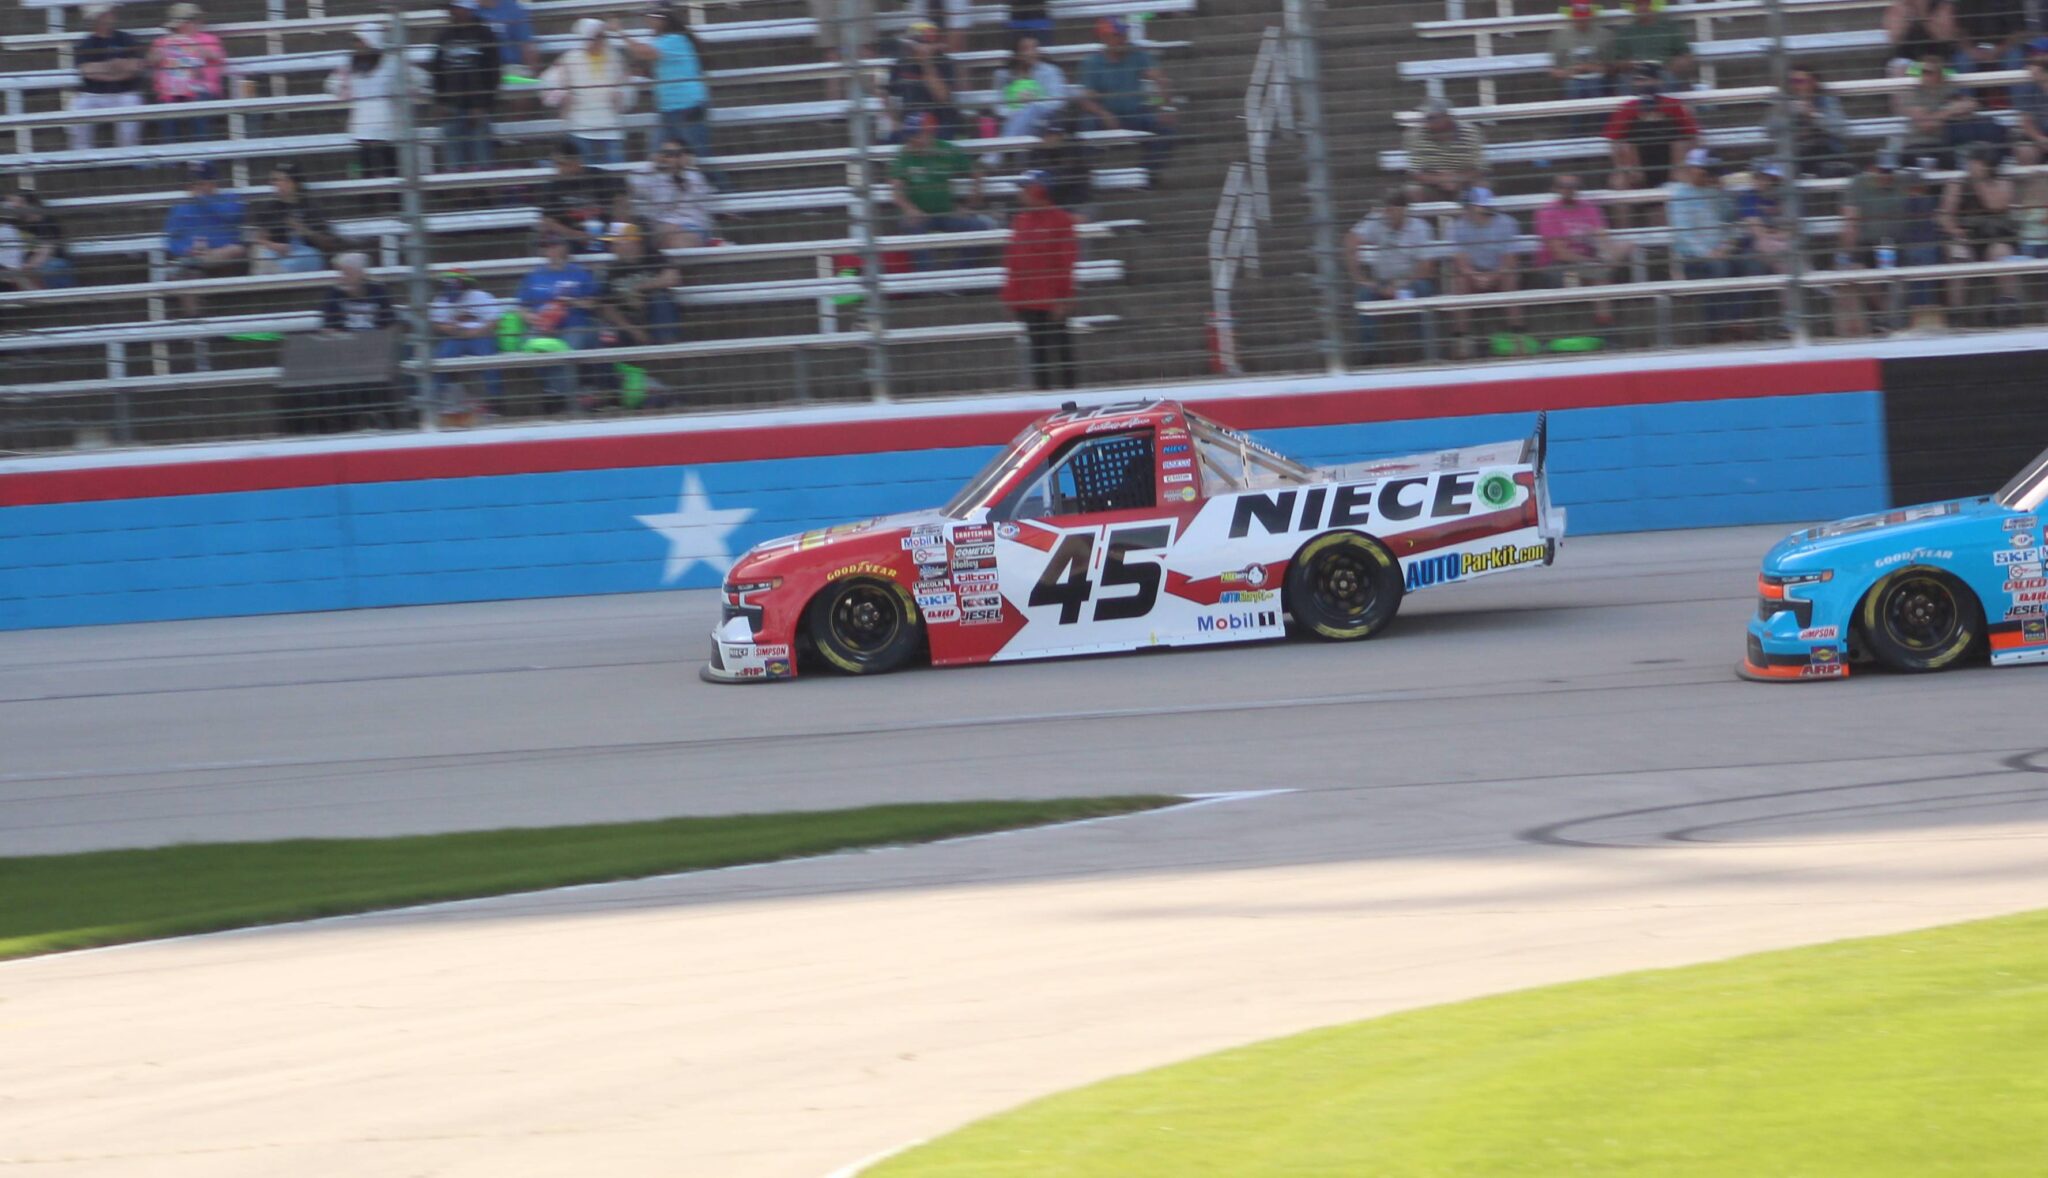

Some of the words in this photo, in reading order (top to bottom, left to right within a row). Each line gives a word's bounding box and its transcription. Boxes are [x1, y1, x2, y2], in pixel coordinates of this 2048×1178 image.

[1229, 470, 1479, 539] NIECE
[955, 530, 993, 539] CRAFTSMAN
[903, 535, 931, 549] Mobil
[1874, 548, 1953, 568] GOODYEAR
[1996, 549, 2036, 564] SKF
[952, 558, 979, 569] Holley
[826, 561, 899, 582] GOODYEAR
[957, 573, 996, 582] tilton
[1028, 525, 1171, 625] 45
[914, 580, 945, 590] LINCOLN
[960, 583, 999, 594] CALICO
[918, 594, 955, 606] SKF
[960, 609, 1001, 621] JESEL
[2004, 604, 2043, 616] JESEL
[1197, 612, 1254, 632] Mobil
[1258, 610, 1276, 627] 1
[1801, 627, 1836, 640] SIMPSON
[755, 646, 787, 656] SIMPSON
[1801, 665, 1841, 676] ARP
